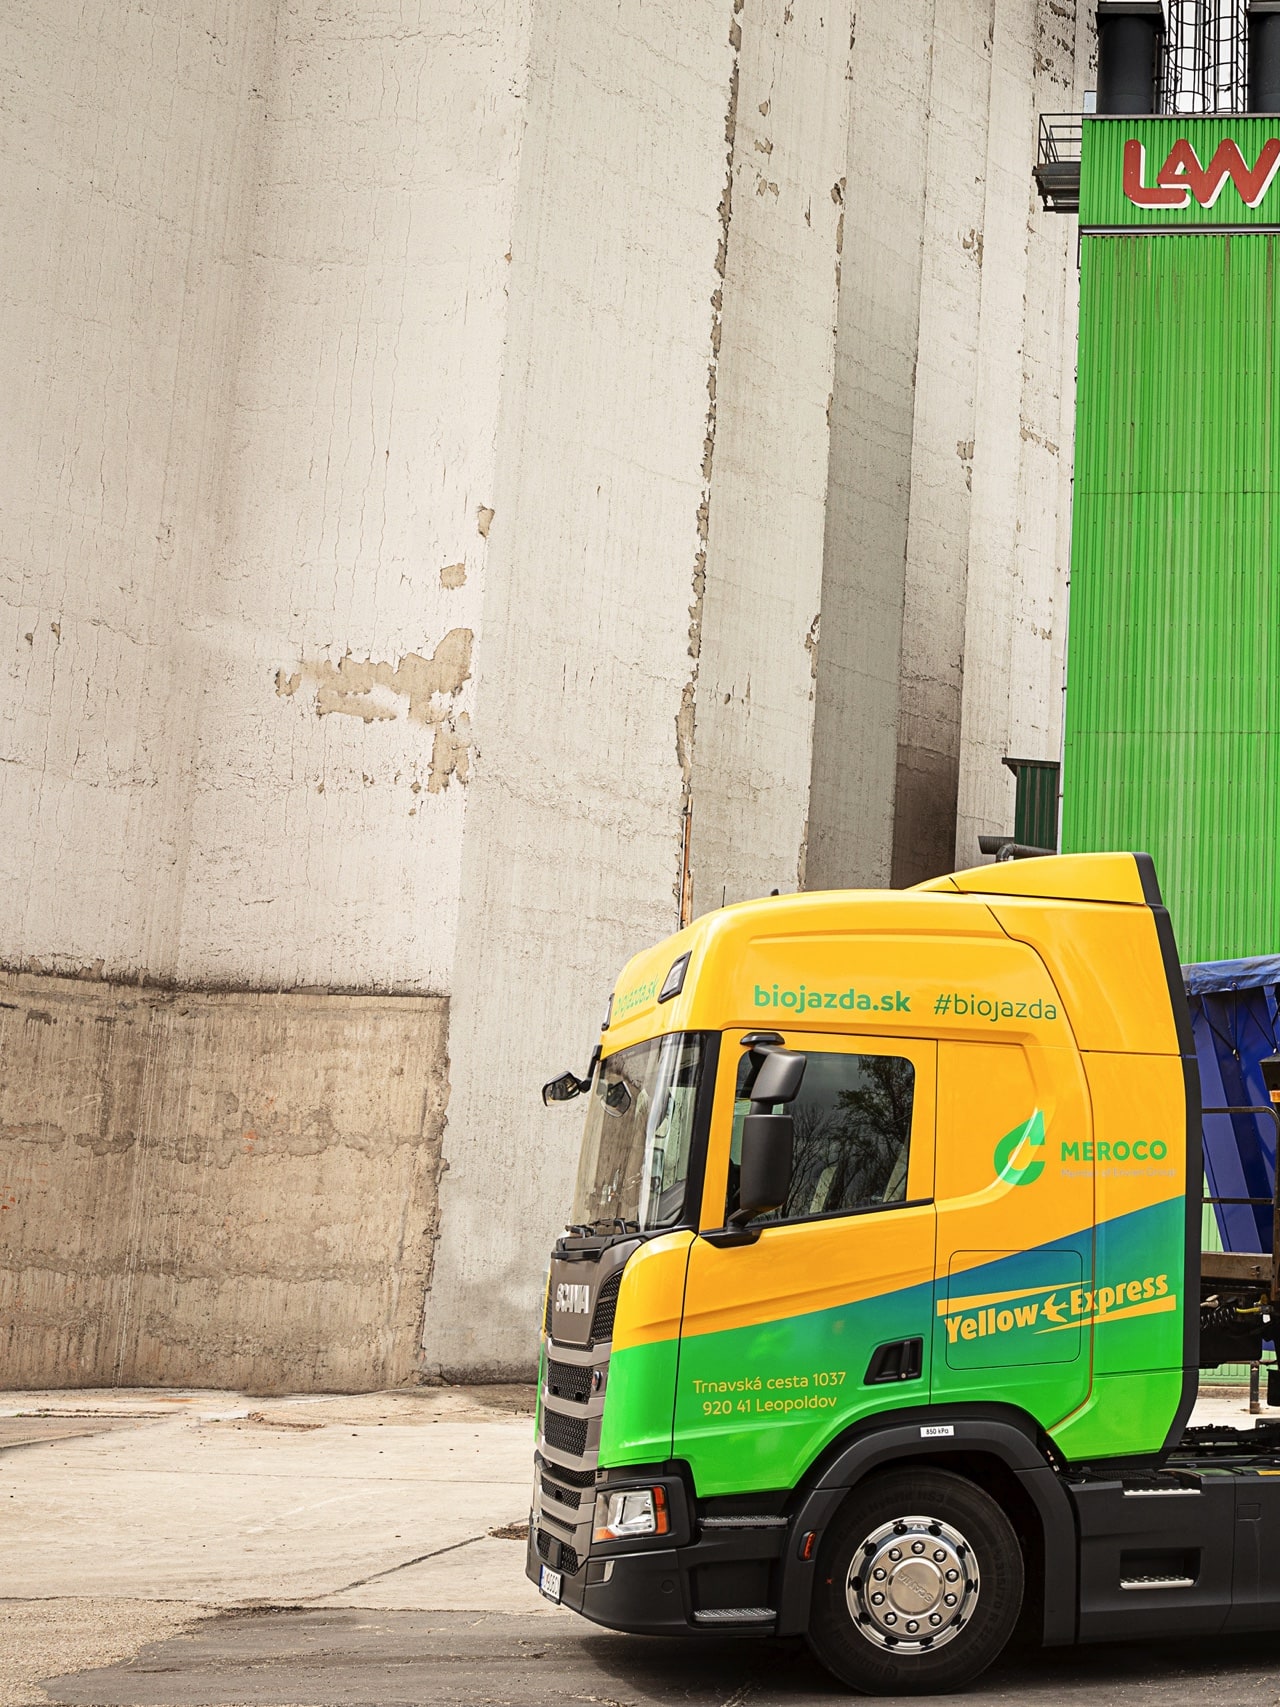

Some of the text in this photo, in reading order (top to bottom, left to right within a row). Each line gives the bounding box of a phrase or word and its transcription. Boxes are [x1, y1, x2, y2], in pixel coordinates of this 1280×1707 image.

[754, 984, 911, 1013] biojazda.sk
[934, 993, 1057, 1022] #biojazda
[1061, 1140, 1167, 1161] MEROCO
[944, 1274, 1168, 1343] Yellow Express
[693, 1372, 846, 1394] Trnavská cesta 1037
[703, 1395, 837, 1415] 920 41 Leopoldov
